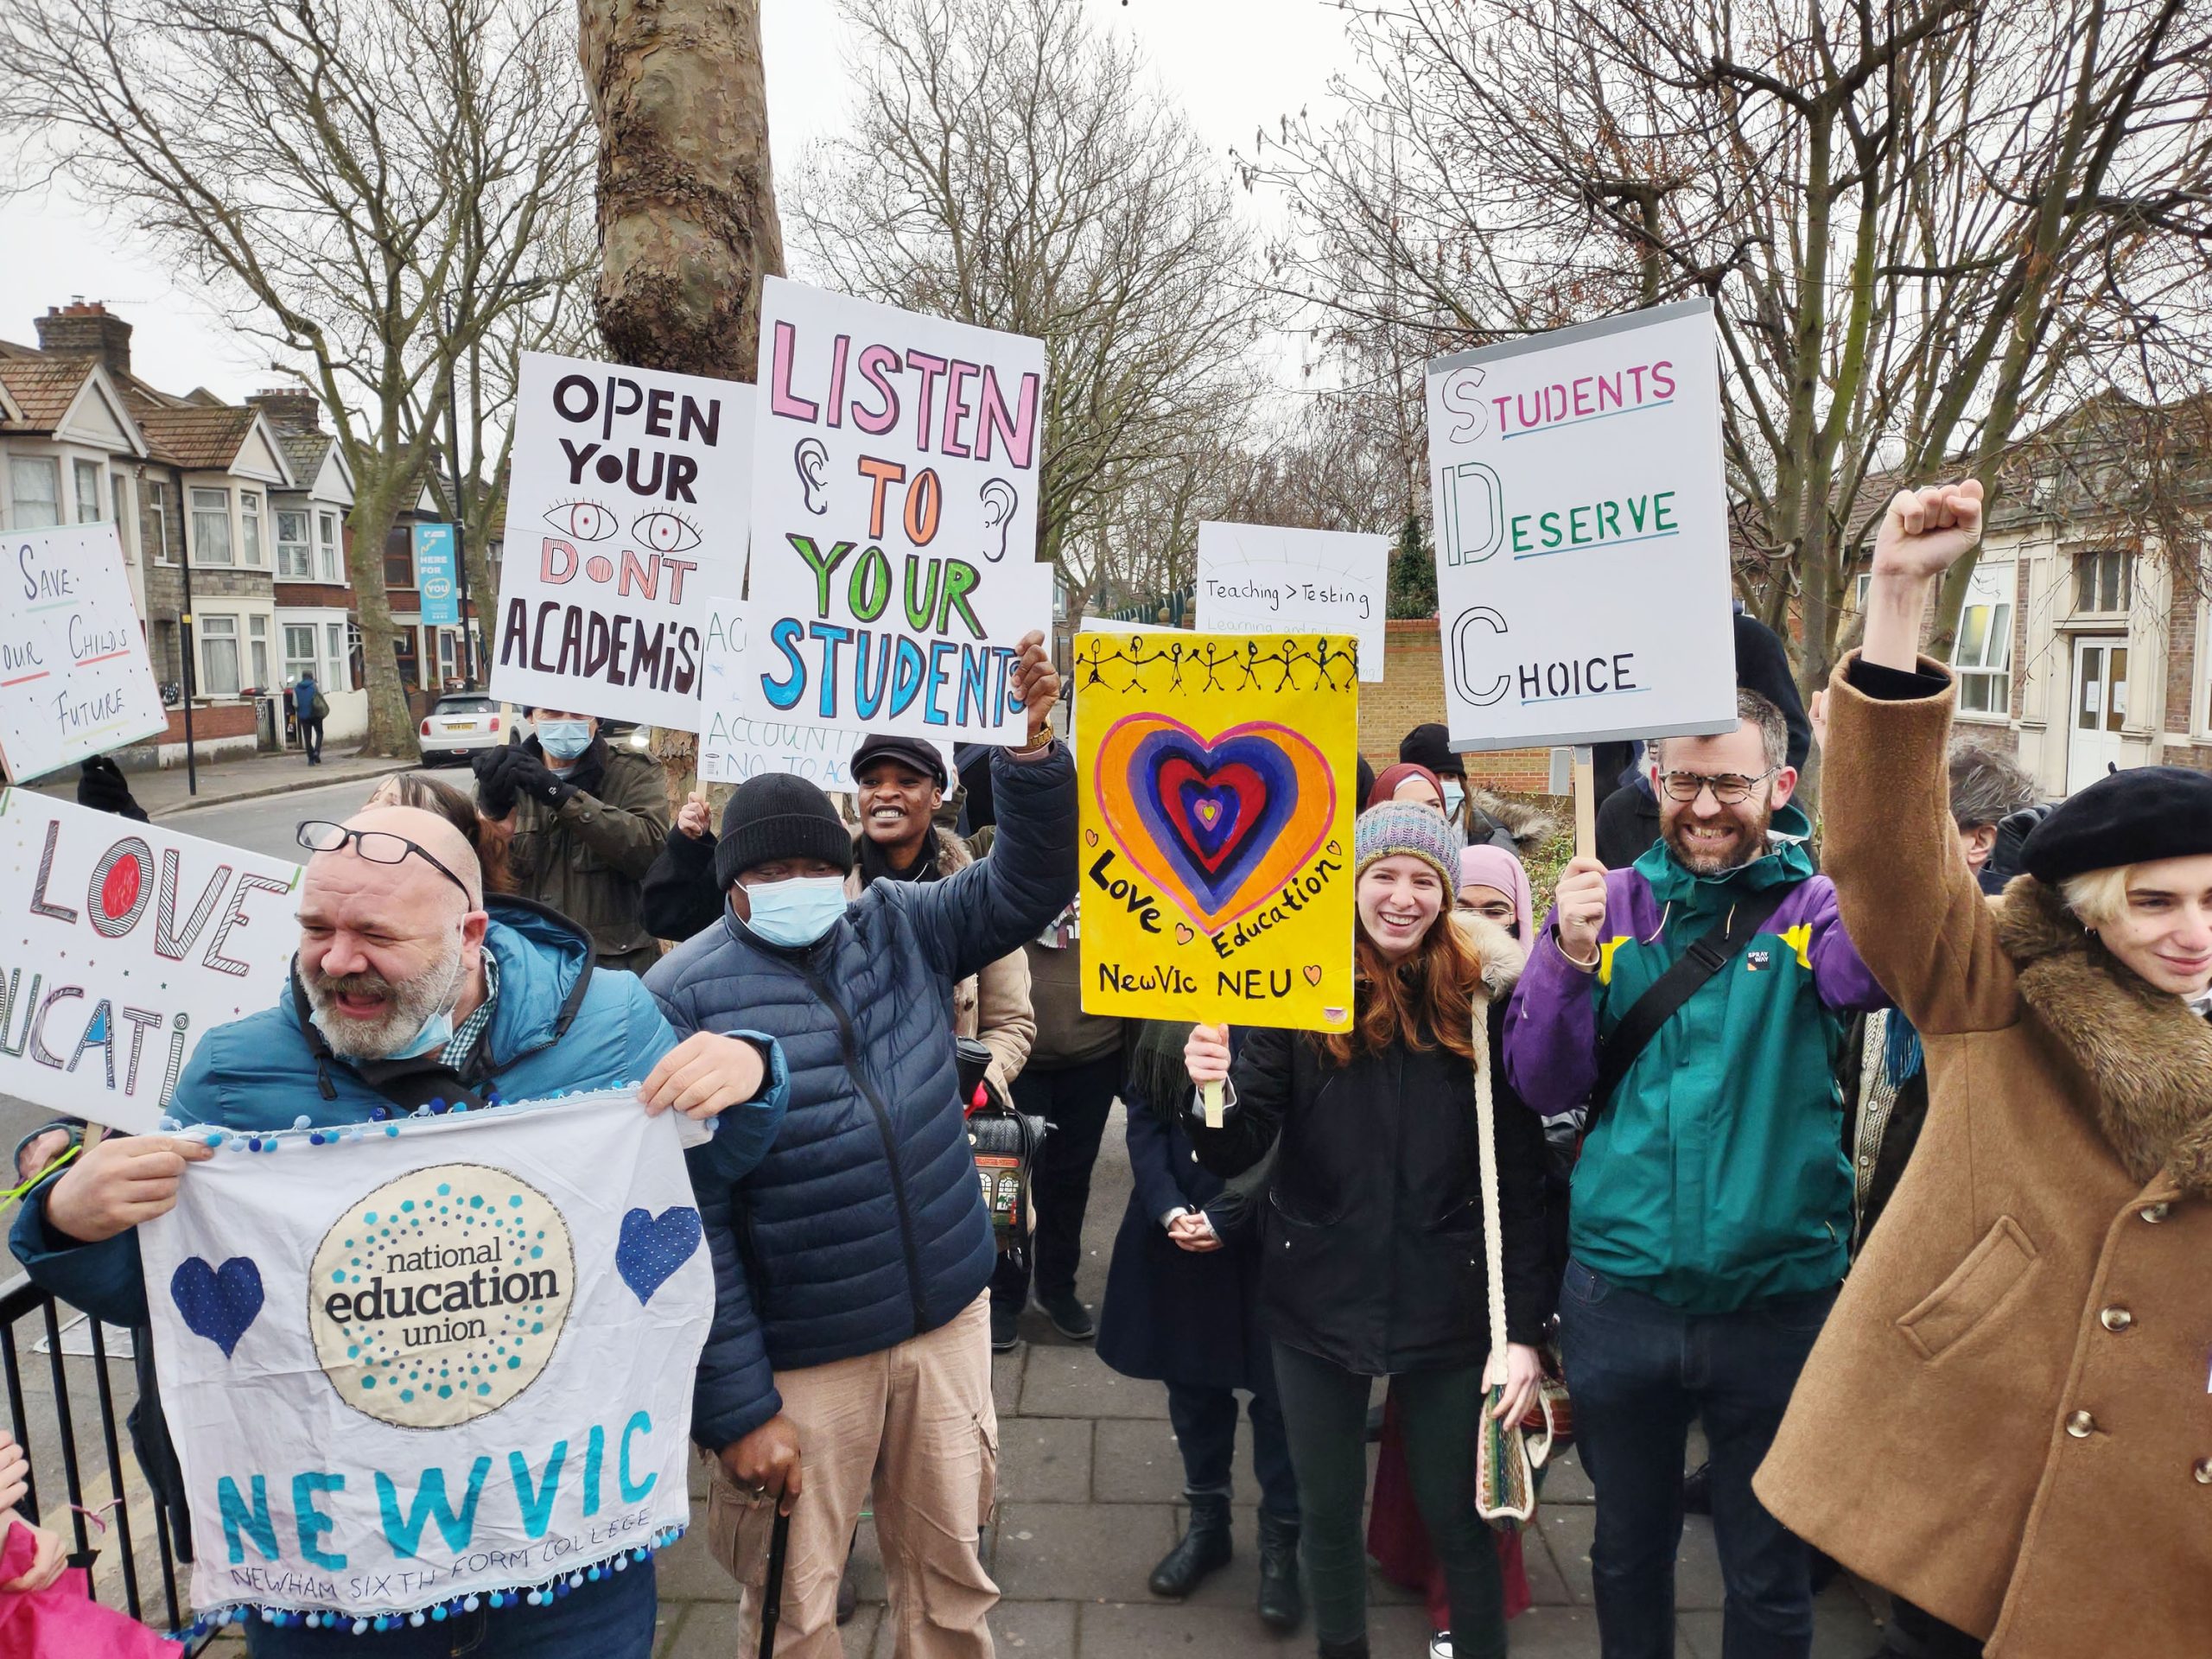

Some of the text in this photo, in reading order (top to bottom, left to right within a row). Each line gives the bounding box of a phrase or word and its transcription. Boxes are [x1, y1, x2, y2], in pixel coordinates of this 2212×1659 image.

[552, 374, 721, 447] OPEN
[771, 319, 1040, 469] LISTEN
[1441, 360, 1676, 444] STUDENTS
[558, 438, 697, 504] YOUR
[858, 454, 943, 547] TO
[1441, 461, 1678, 566] DESERVE
[420, 566, 442, 575] FOR
[785, 532, 989, 640] YOUR
[1206, 580, 1280, 610] Teaching
[1302, 584, 1370, 620] Testing
[3, 641, 43, 671] OUR
[499, 597, 702, 702] ACADEMiS
[706, 611, 747, 653] AC
[1451, 607, 1638, 707] CHOICE
[30, 819, 292, 977] LOVE
[1088, 849, 1343, 960] Love Education
[1217, 969, 1293, 1001] NEU
[324, 1265, 561, 1325] education
[386, 1236, 503, 1274] national
[402, 1314, 487, 1348] union
[216, 1410, 660, 1572] NEWVIC
[230, 1506, 651, 1599] NEWHAM SIXTH FORM COLLEGE
